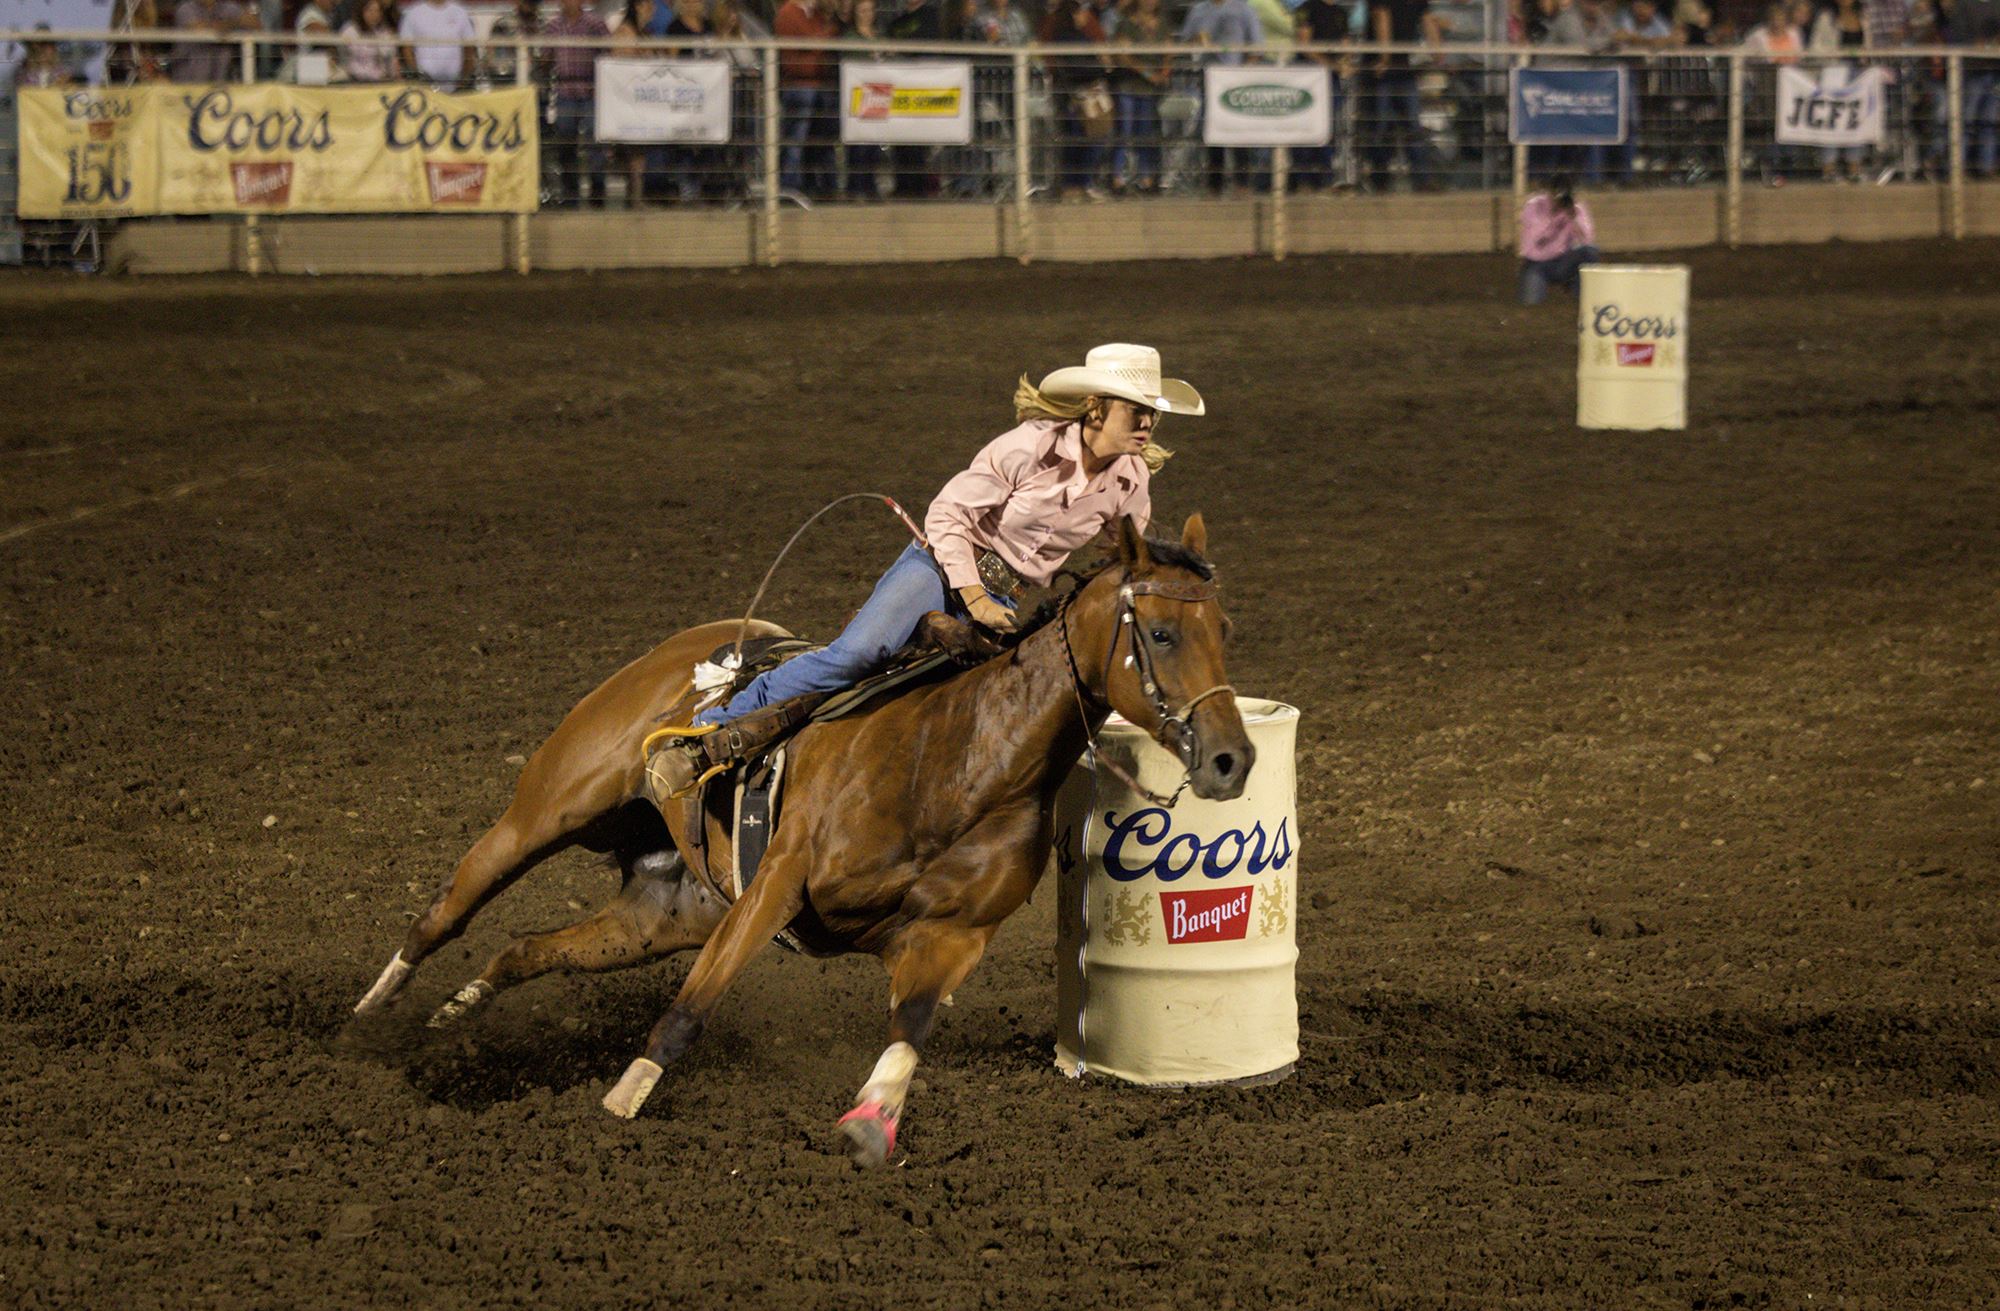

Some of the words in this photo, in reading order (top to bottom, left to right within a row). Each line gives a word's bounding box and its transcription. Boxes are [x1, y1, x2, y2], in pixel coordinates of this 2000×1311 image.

[64, 92, 132, 119] Coors
[183, 90, 335, 153] Coors
[380, 89, 526, 153] Coors
[62, 142, 132, 204] 150
[1593, 304, 1676, 338] Coors
[1103, 807, 1293, 882] Coors
[1171, 892, 1247, 940] Banquet
